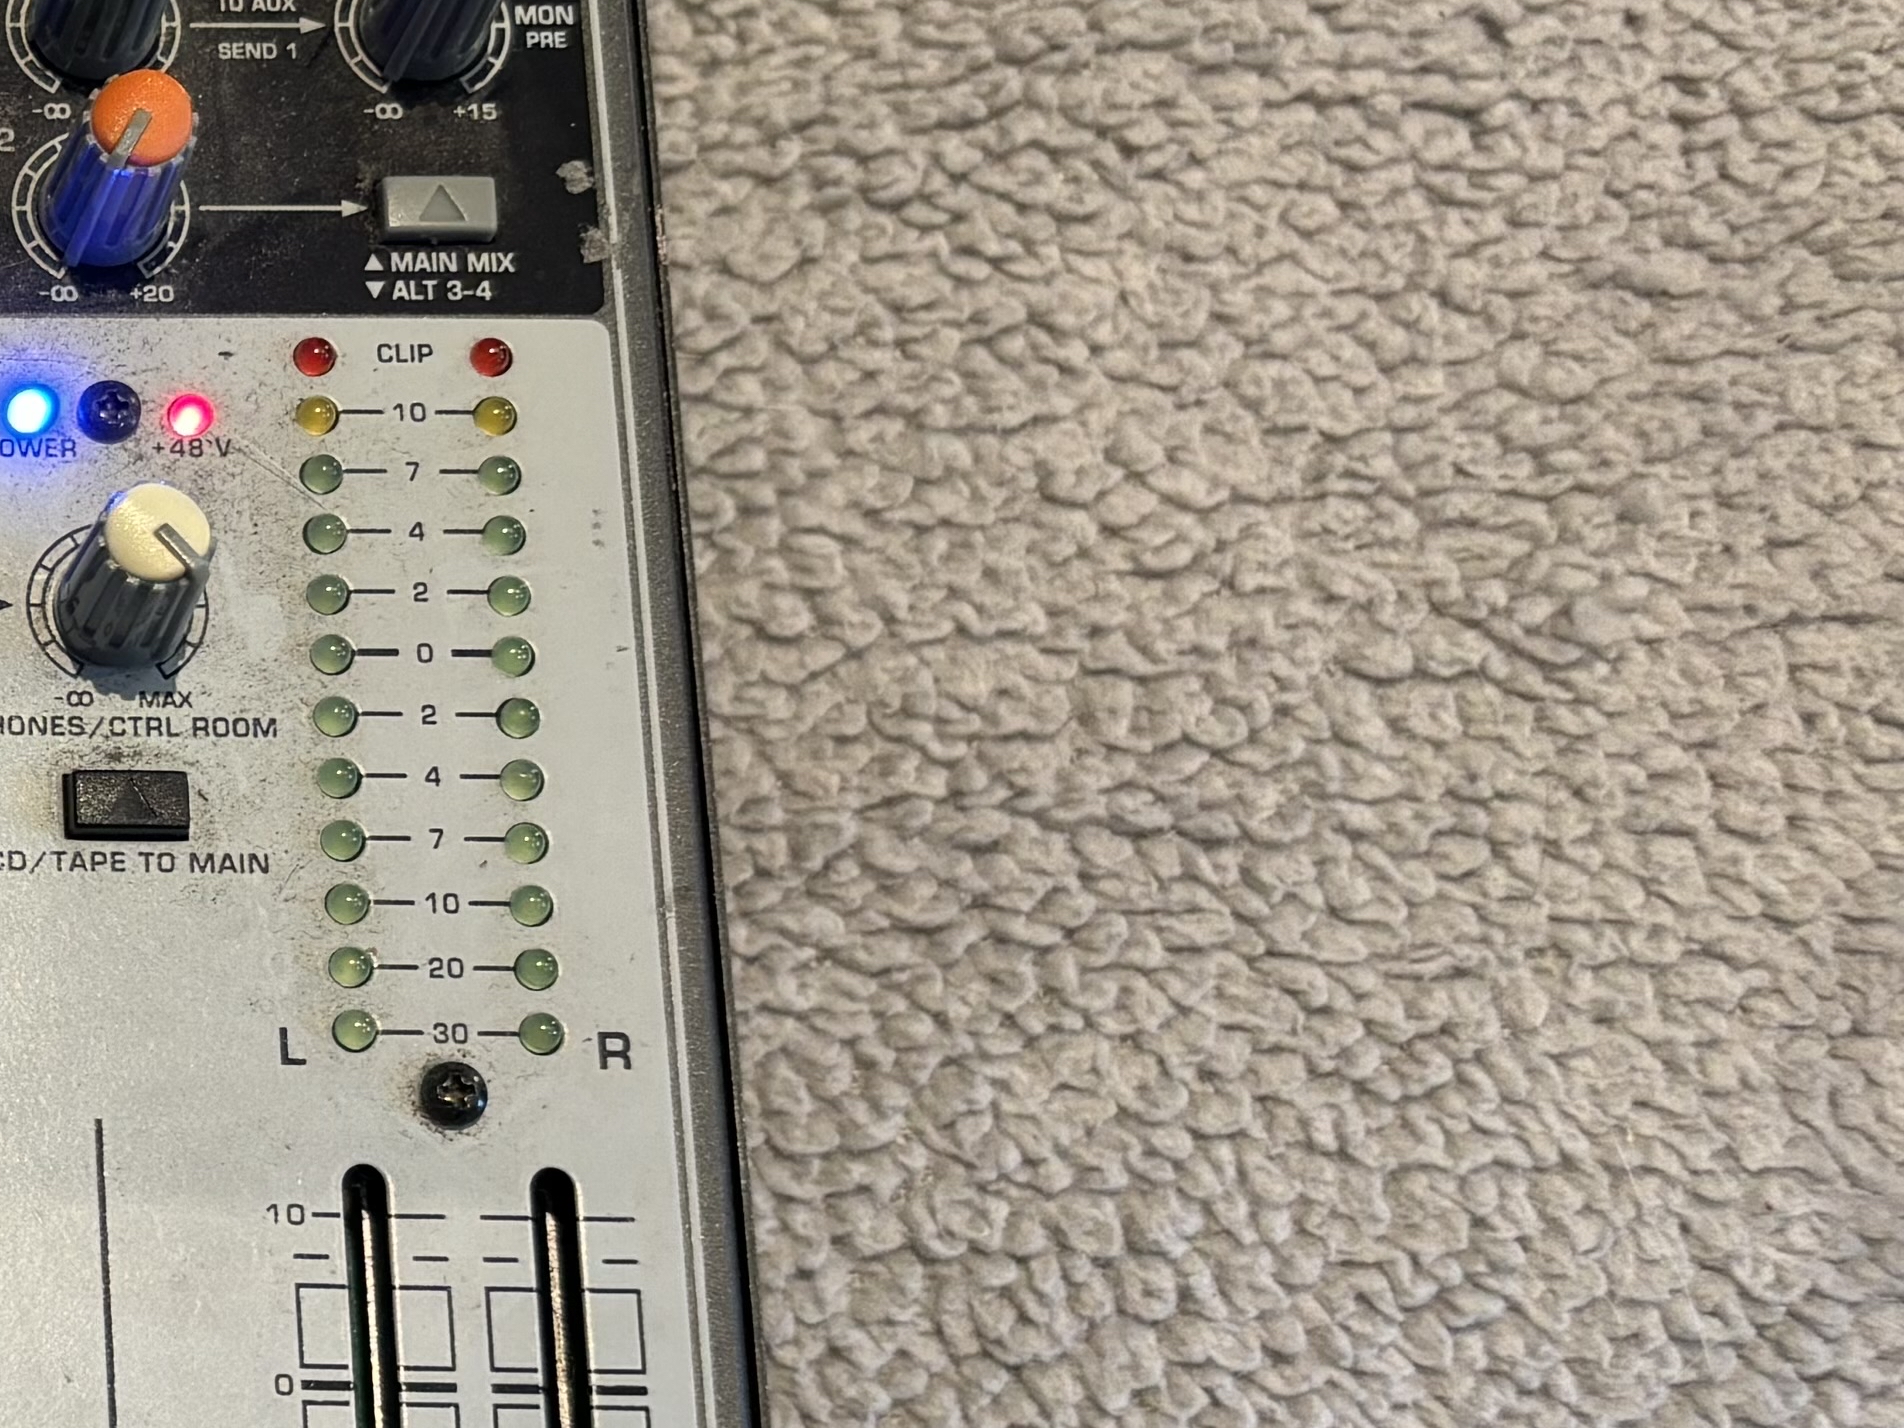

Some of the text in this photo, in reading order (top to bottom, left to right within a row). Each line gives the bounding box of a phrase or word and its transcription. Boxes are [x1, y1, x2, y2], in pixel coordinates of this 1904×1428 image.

[514, 6, 574, 27] MON
[526, 31, 567, 49] PRE
[218, 42, 296, 60] SEND 1
[392, 252, 516, 273] MAIN MIX
[392, 281, 492, 301] ALT 3-4
[376, 343, 433, 364] CLIP
[393, 403, 426, 423] 10
[139, 691, 193, 709] MAX
[193, 717, 279, 739] ROOM
[143, 852, 175, 873] TO
[189, 852, 270, 874] MAIN
[428, 958, 464, 979] 20
[279, 1027, 306, 1066] L
[599, 1032, 633, 1070] R
